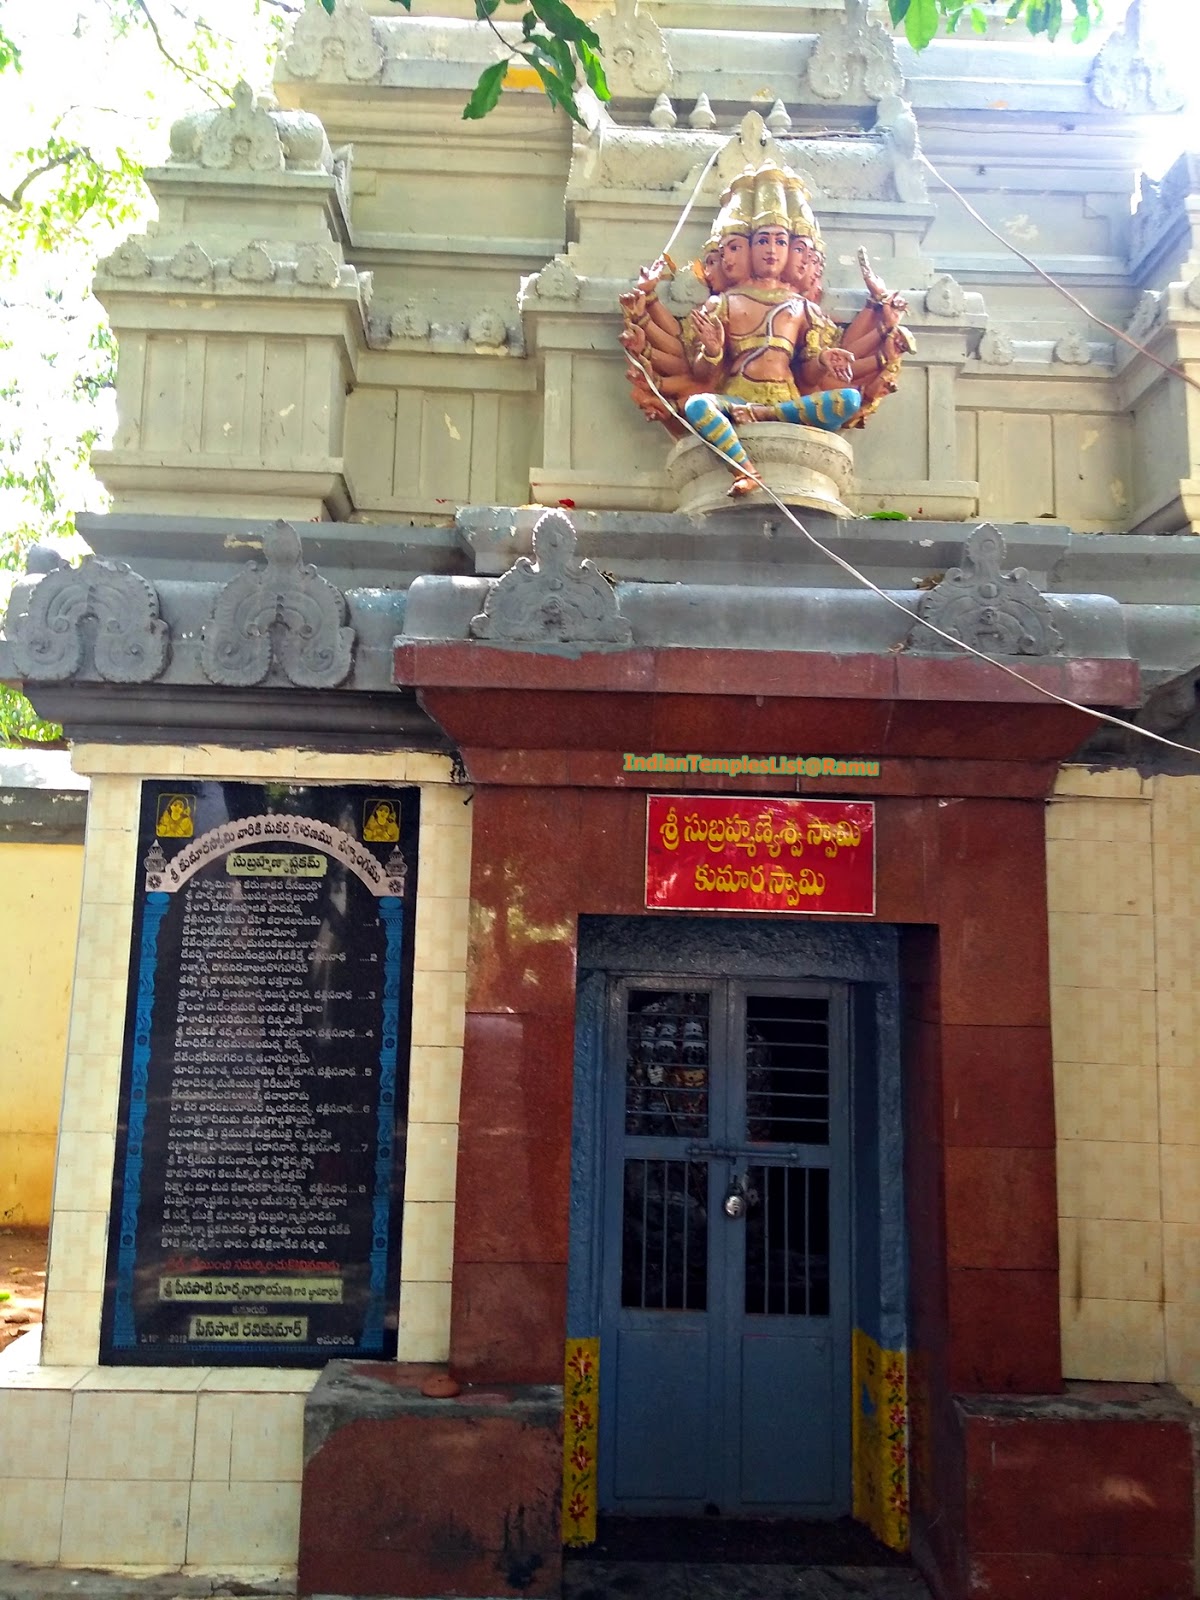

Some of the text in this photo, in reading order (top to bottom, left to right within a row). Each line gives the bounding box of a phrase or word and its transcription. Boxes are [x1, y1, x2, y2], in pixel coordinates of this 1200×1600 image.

[659, 806, 679, 850] శ్రీ
[806, 817, 862, 858] స్వామి
[170, 868, 180, 884] శ్రీ
[694, 863, 826, 907] కుమార స్వామి
